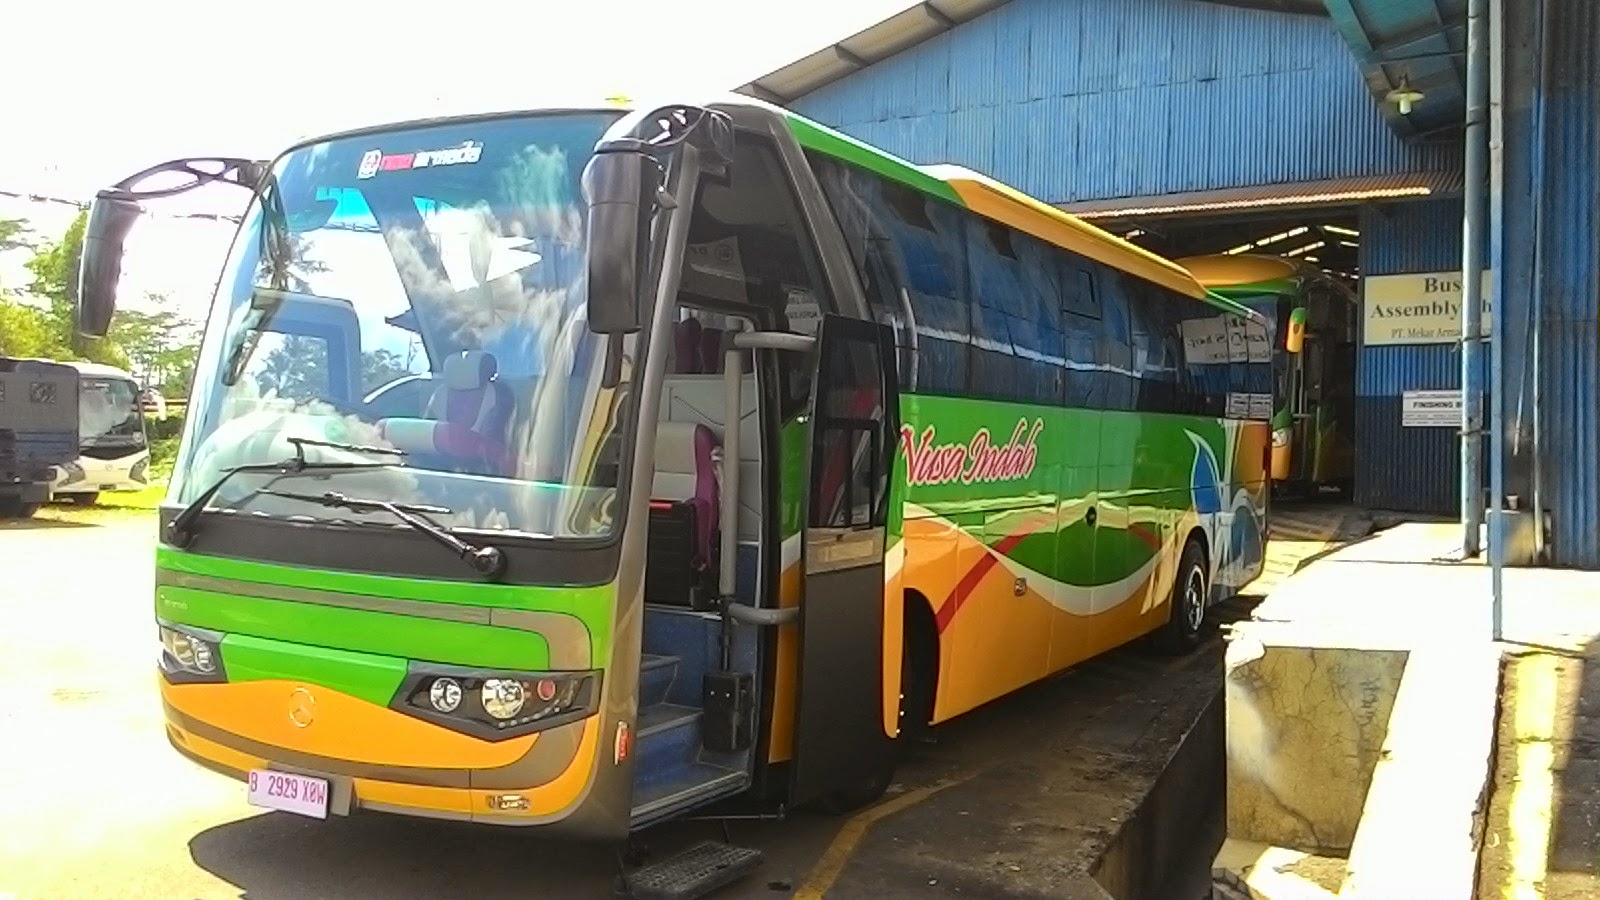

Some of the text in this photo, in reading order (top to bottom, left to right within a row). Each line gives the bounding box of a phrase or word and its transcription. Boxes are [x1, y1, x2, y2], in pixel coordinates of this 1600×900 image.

[1424, 277, 1462, 293] Bus
[1370, 300, 1460, 320] Assembly
[900, 416, 1044, 487] Nusa Indah
[267, 775, 299, 800] 2929
